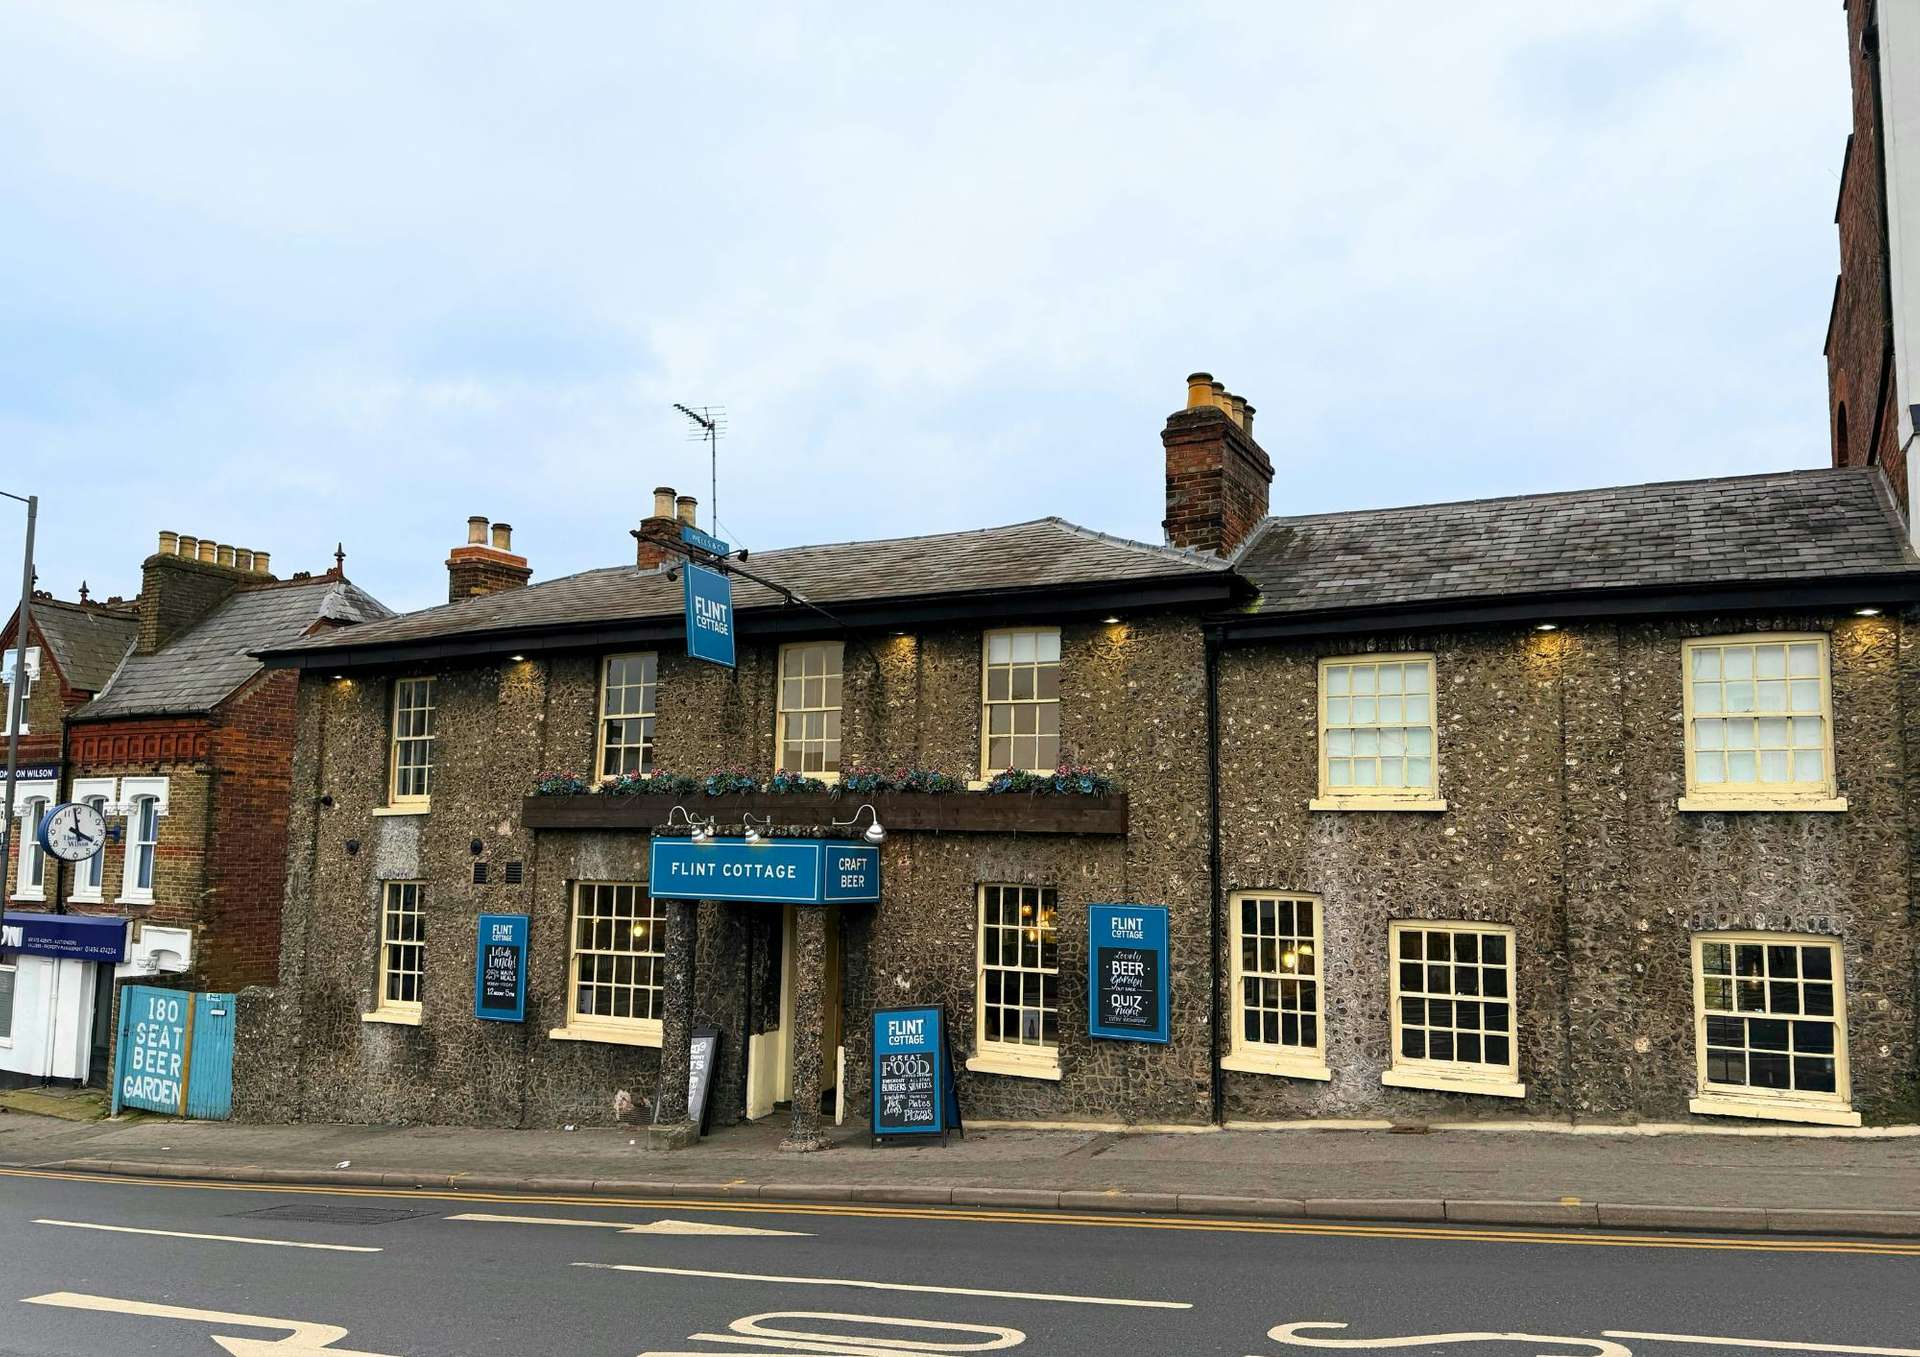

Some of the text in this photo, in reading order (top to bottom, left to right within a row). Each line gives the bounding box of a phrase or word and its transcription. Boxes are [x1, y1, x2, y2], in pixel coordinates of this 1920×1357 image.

[695, 596, 727, 622] FLINT
[696, 616, 729, 636] COTTAGE
[27, 769, 53, 778] WILSON
[671, 861, 796, 879] FLINT COTTAGE
[838, 857, 867, 871] CRAFT
[841, 875, 865, 888] BEER
[492, 924, 513, 935] FLINT
[1111, 917, 1144, 931] FLINT
[492, 934, 513, 942] COTTAGE
[1111, 930, 1144, 940] COTTAGE
[1111, 960, 1145, 977] BEER
[148, 997, 178, 1022] 180
[1111, 994, 1143, 1011] QUIZ
[136, 1022, 183, 1050] SEAT
[888, 1019, 924, 1036] FLINT
[888, 1035, 925, 1045] COTTAGE
[133, 1046, 182, 1078] BEER
[889, 1054, 922, 1062] GREAT
[881, 1059, 930, 1077] FOOD
[123, 1075, 182, 1106] GARDEN
[882, 1083, 907, 1092] BURGERS
